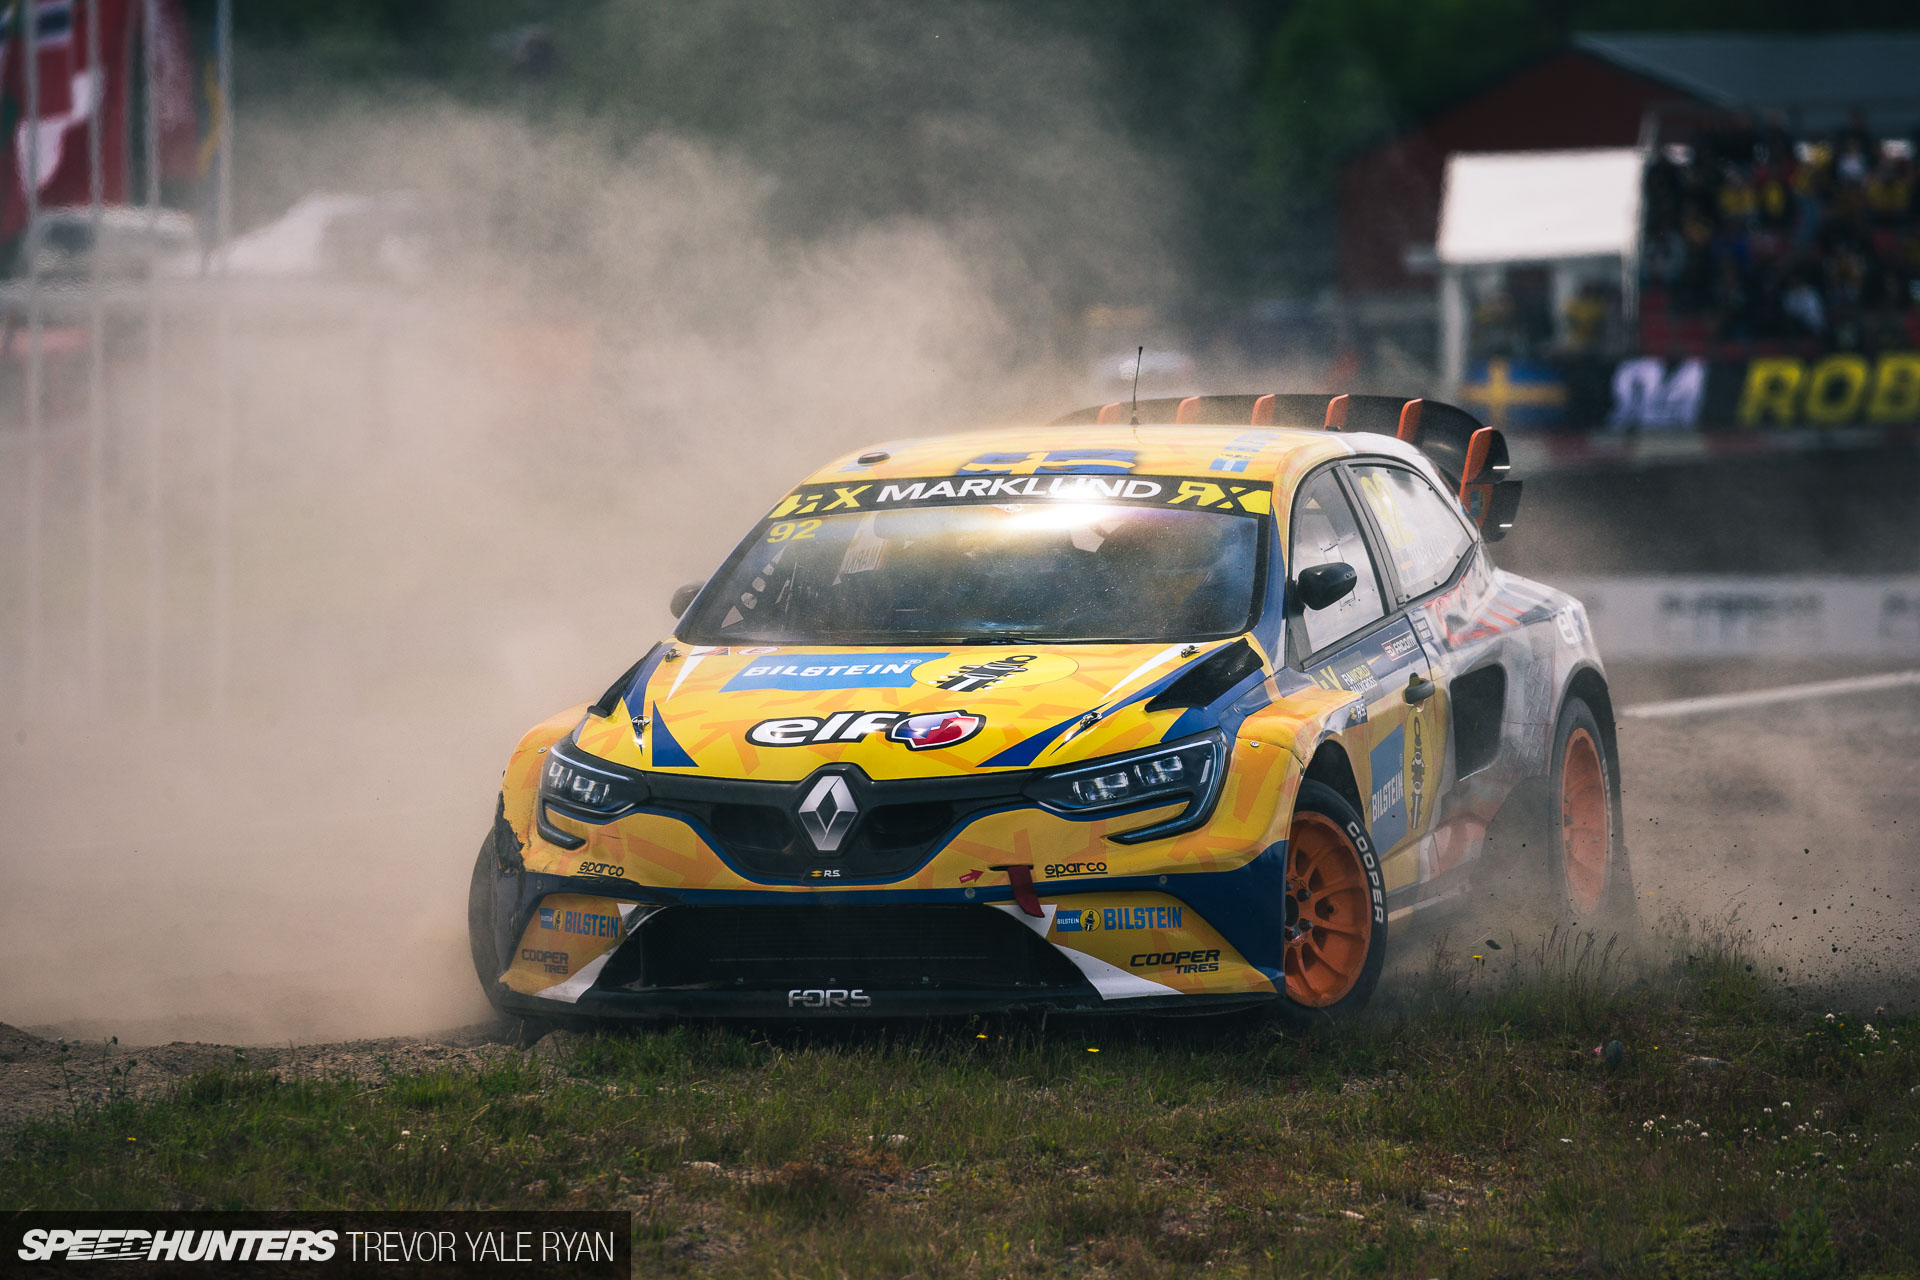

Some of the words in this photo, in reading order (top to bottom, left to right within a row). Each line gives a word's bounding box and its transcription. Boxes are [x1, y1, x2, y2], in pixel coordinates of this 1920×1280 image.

[876, 477, 1162, 503] MARKLUND
[766, 519, 823, 544] 92
[742, 663, 911, 677] BILSTEIN
[750, 712, 902, 744] elf
[1371, 769, 1404, 824] BILSTEIN
[578, 861, 625, 877] sparco
[823, 869, 841, 877] RS
[1044, 861, 1107, 878] sparco
[1346, 820, 1384, 924] COOPER
[564, 911, 619, 938] BILSTEIN
[1057, 918, 1080, 926] BILSTEIN
[1103, 906, 1182, 931] BILSTEIN
[522, 949, 569, 964] COOPER
[1129, 949, 1221, 967] COOPER
[544, 964, 569, 974] TIRES
[1174, 963, 1219, 974] TIRES
[788, 989, 872, 1008] FORS
